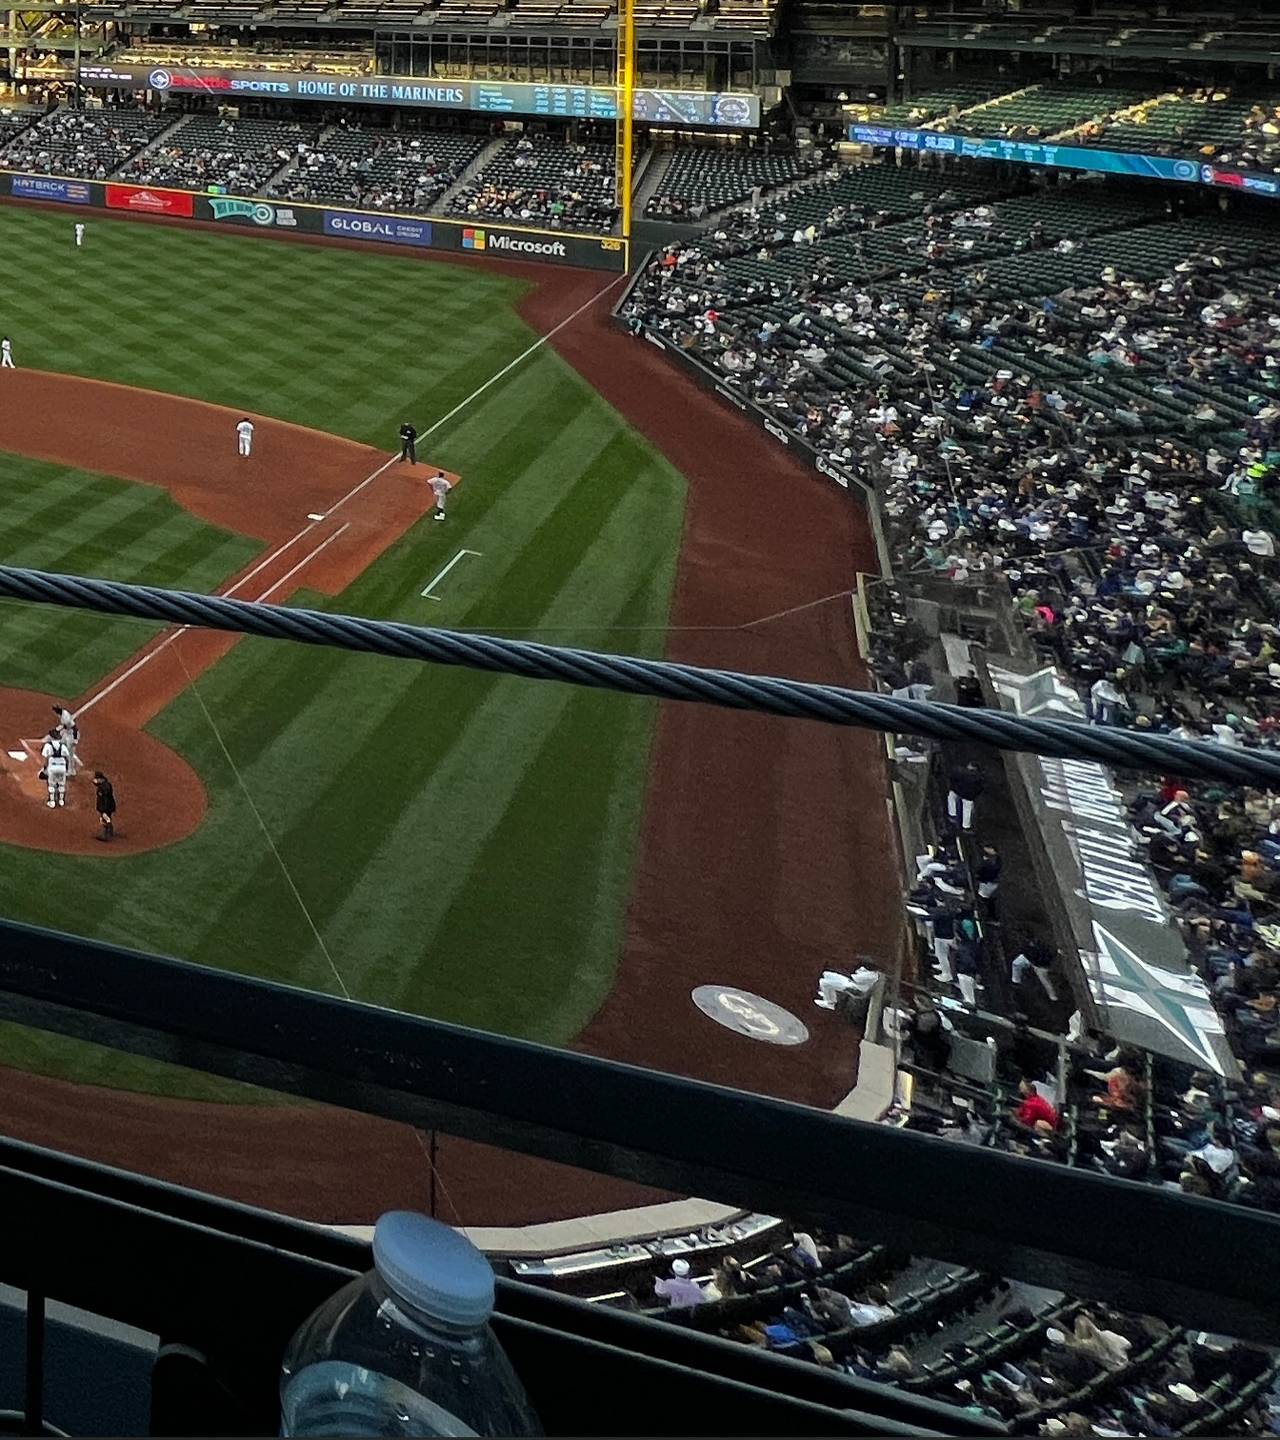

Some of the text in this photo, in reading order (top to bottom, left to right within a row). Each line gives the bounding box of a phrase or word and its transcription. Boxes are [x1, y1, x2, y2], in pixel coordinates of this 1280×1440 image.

[231, 79, 290, 93] SPORTS
[298, 80, 336, 95] HOME
[339, 82, 357, 96] OF
[361, 84, 388, 99] THE
[392, 85, 464, 103] MARINERS
[331, 218, 394, 236] GLOBAL
[489, 234, 566, 257] Microsoft
